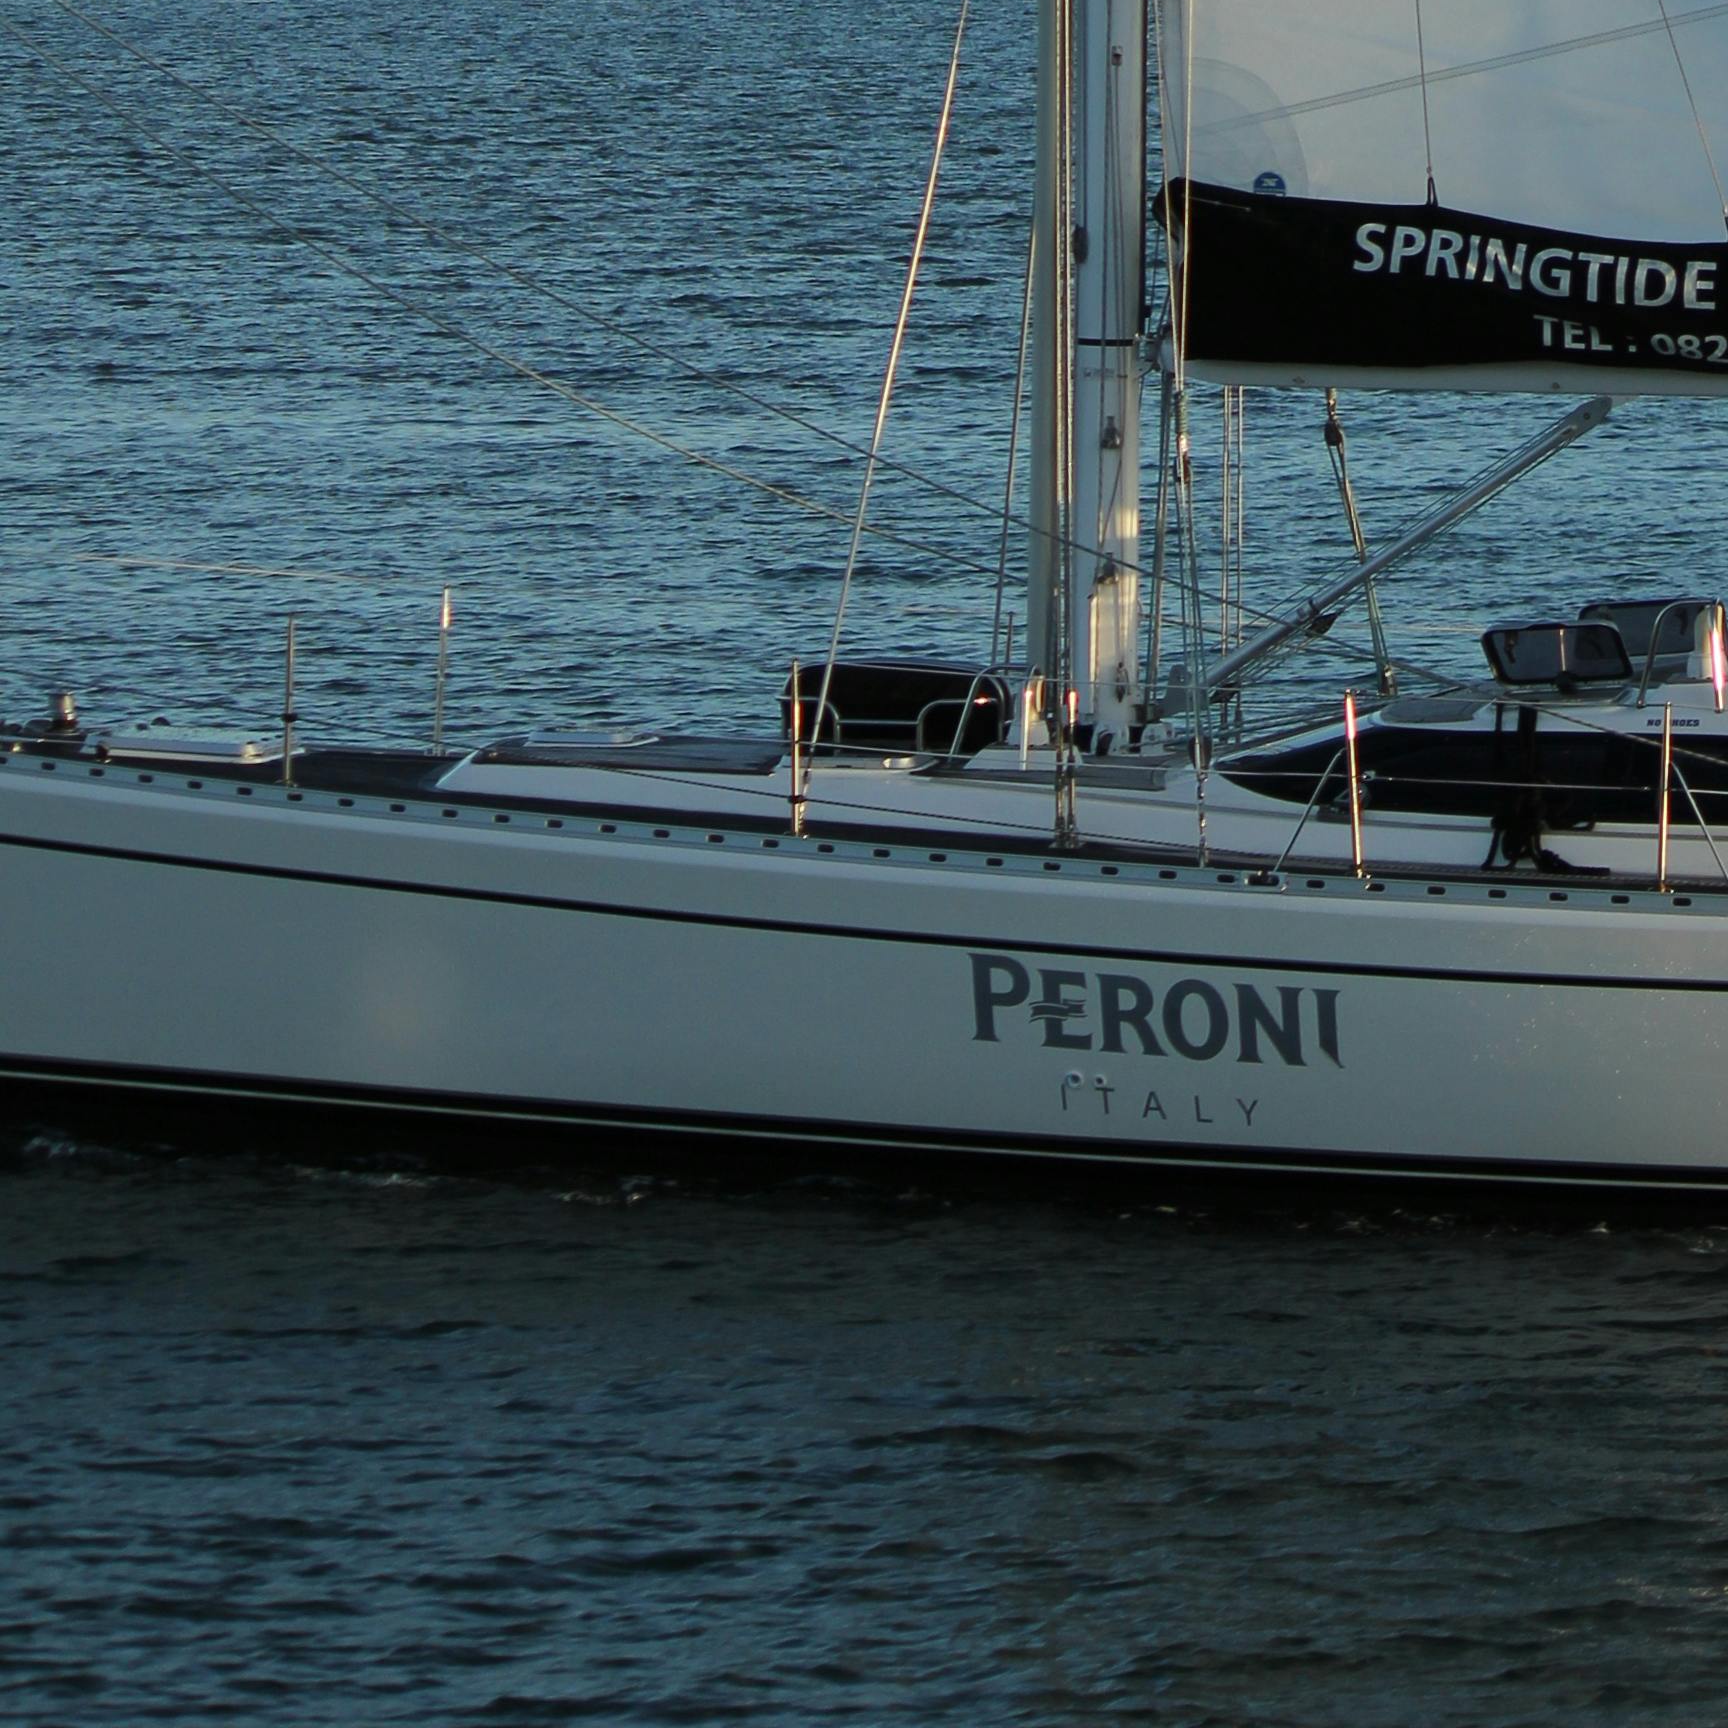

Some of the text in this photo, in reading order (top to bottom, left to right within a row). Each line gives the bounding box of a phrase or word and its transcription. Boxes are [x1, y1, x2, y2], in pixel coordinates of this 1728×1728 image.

[1353, 222, 1718, 309] SPRINGTIDE
[1533, 314, 1613, 352] TEL
[1647, 718, 1700, 728] NO HOES
[968, 952, 1345, 1069] PERONI
[1060, 1084, 1259, 1127] ITALY
